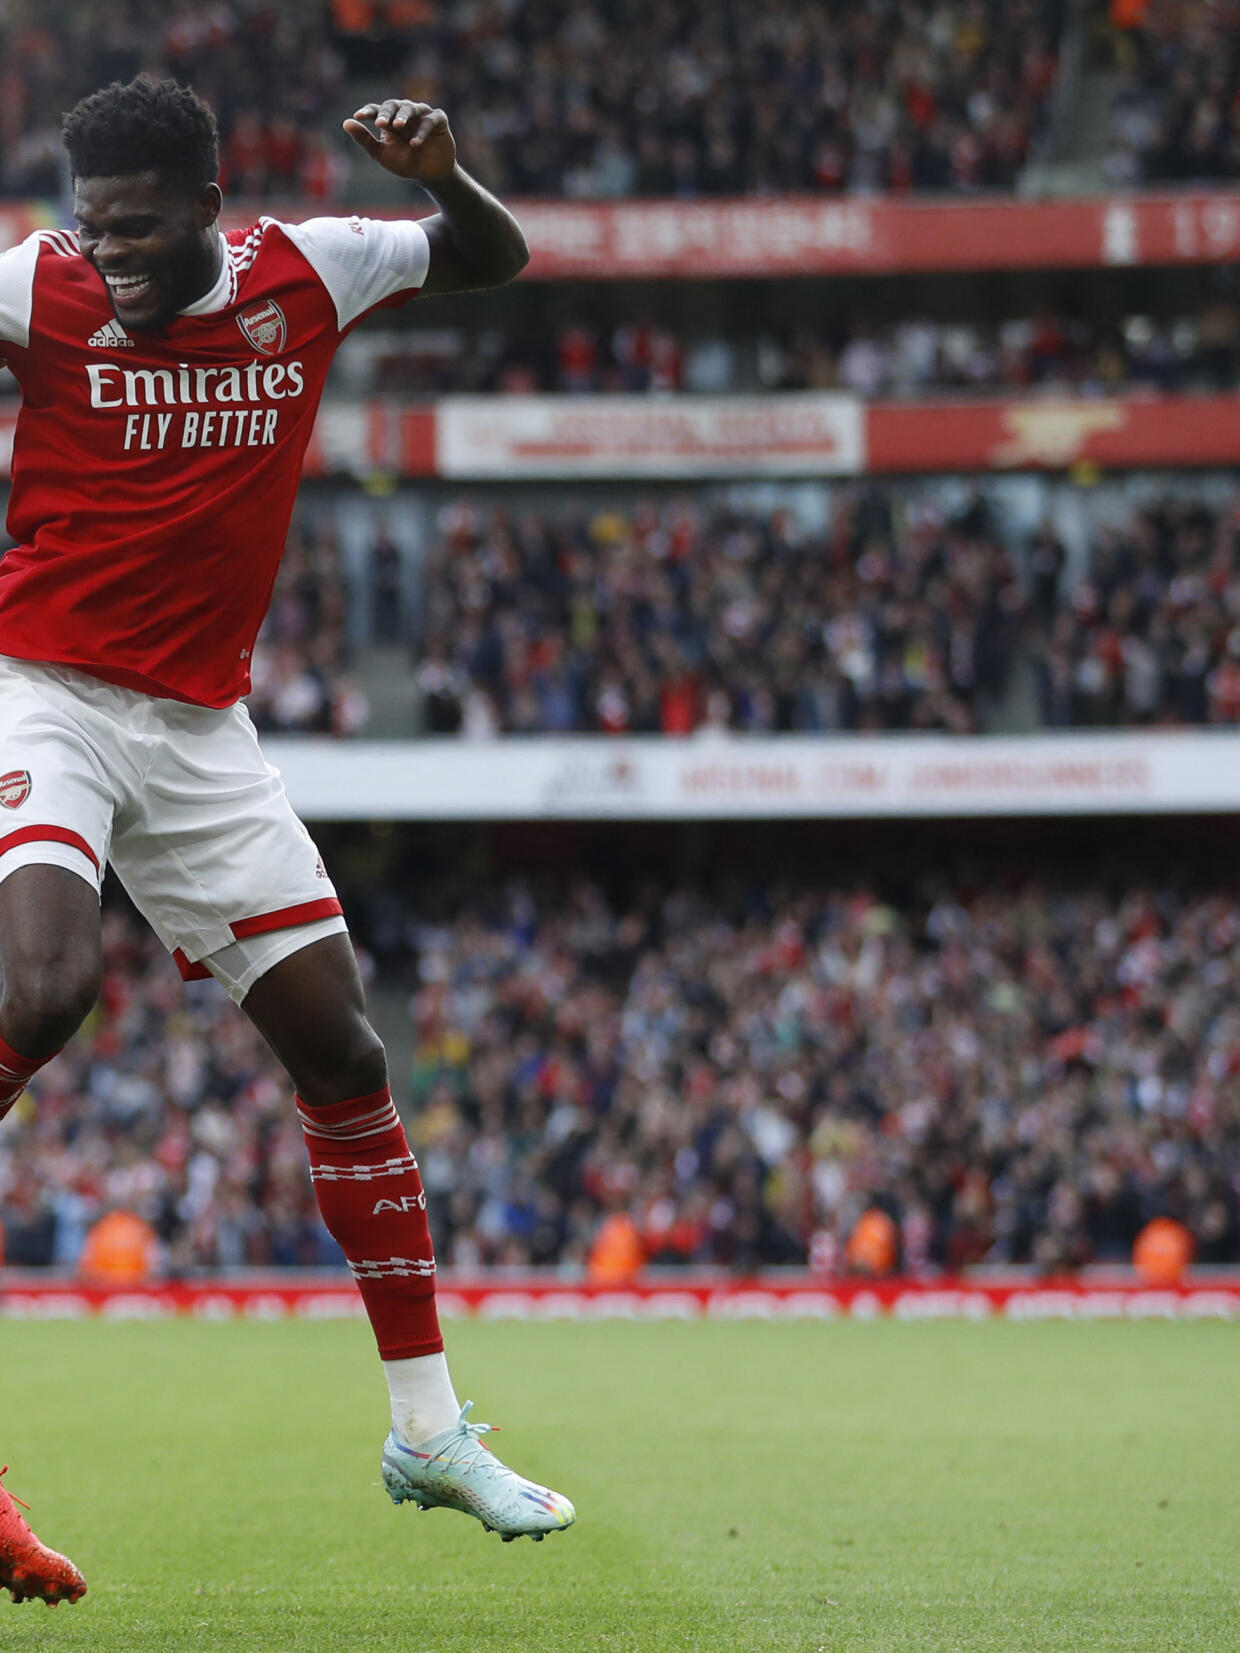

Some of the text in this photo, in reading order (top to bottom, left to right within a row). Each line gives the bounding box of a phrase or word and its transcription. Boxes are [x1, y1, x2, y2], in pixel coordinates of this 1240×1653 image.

[244, 306, 275, 328] Arsenal
[88, 336, 135, 347] adidas
[85, 359, 304, 408] Emirates
[124, 409, 278, 450] FLY BETTER
